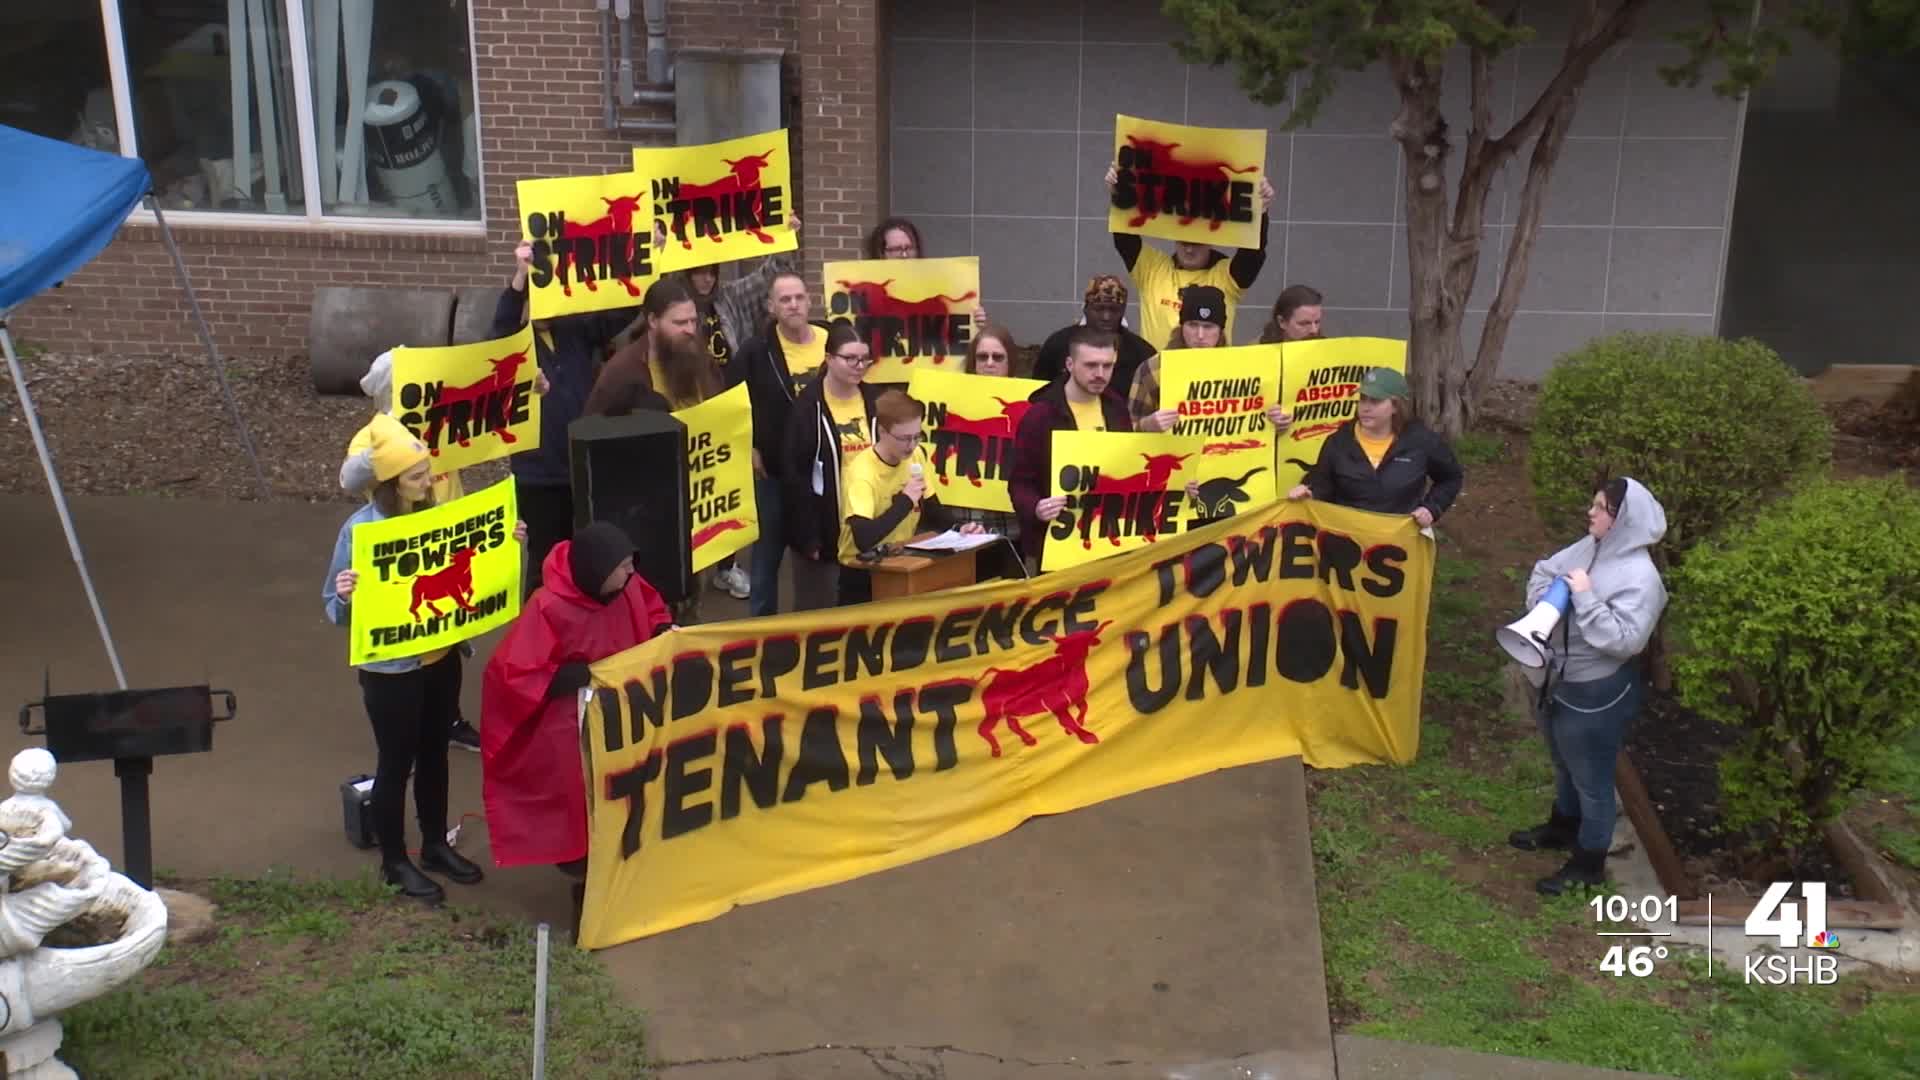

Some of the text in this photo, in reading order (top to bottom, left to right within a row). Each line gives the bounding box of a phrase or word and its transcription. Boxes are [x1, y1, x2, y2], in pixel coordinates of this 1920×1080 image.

[1117, 145, 1152, 169] ON
[1111, 168, 1253, 223] STRIKE
[528, 211, 565, 238] ON
[530, 231, 652, 288] STRIKE
[831, 291, 868, 315] ON
[1187, 377, 1261, 400] NOTHING
[1307, 366, 1370, 387] NOTHIN
[401, 381, 443, 409] ON
[1177, 396, 1264, 416] ABOUT US
[1296, 384, 1358, 402] ABOUT
[400, 380, 532, 448] STRIKE
[1172, 412, 1266, 436] WITHOUT US
[1059, 464, 1099, 492] ON
[1050, 490, 1185, 541] STRIKE
[373, 506, 505, 557] INDEPENDENCE
[372, 523, 506, 582] TOWERS
[369, 590, 508, 647] TENANT UNION
[602, 521, 1408, 752] INDEPENDENCE TOWERS
[604, 597, 1399, 860] TENANT UNION
